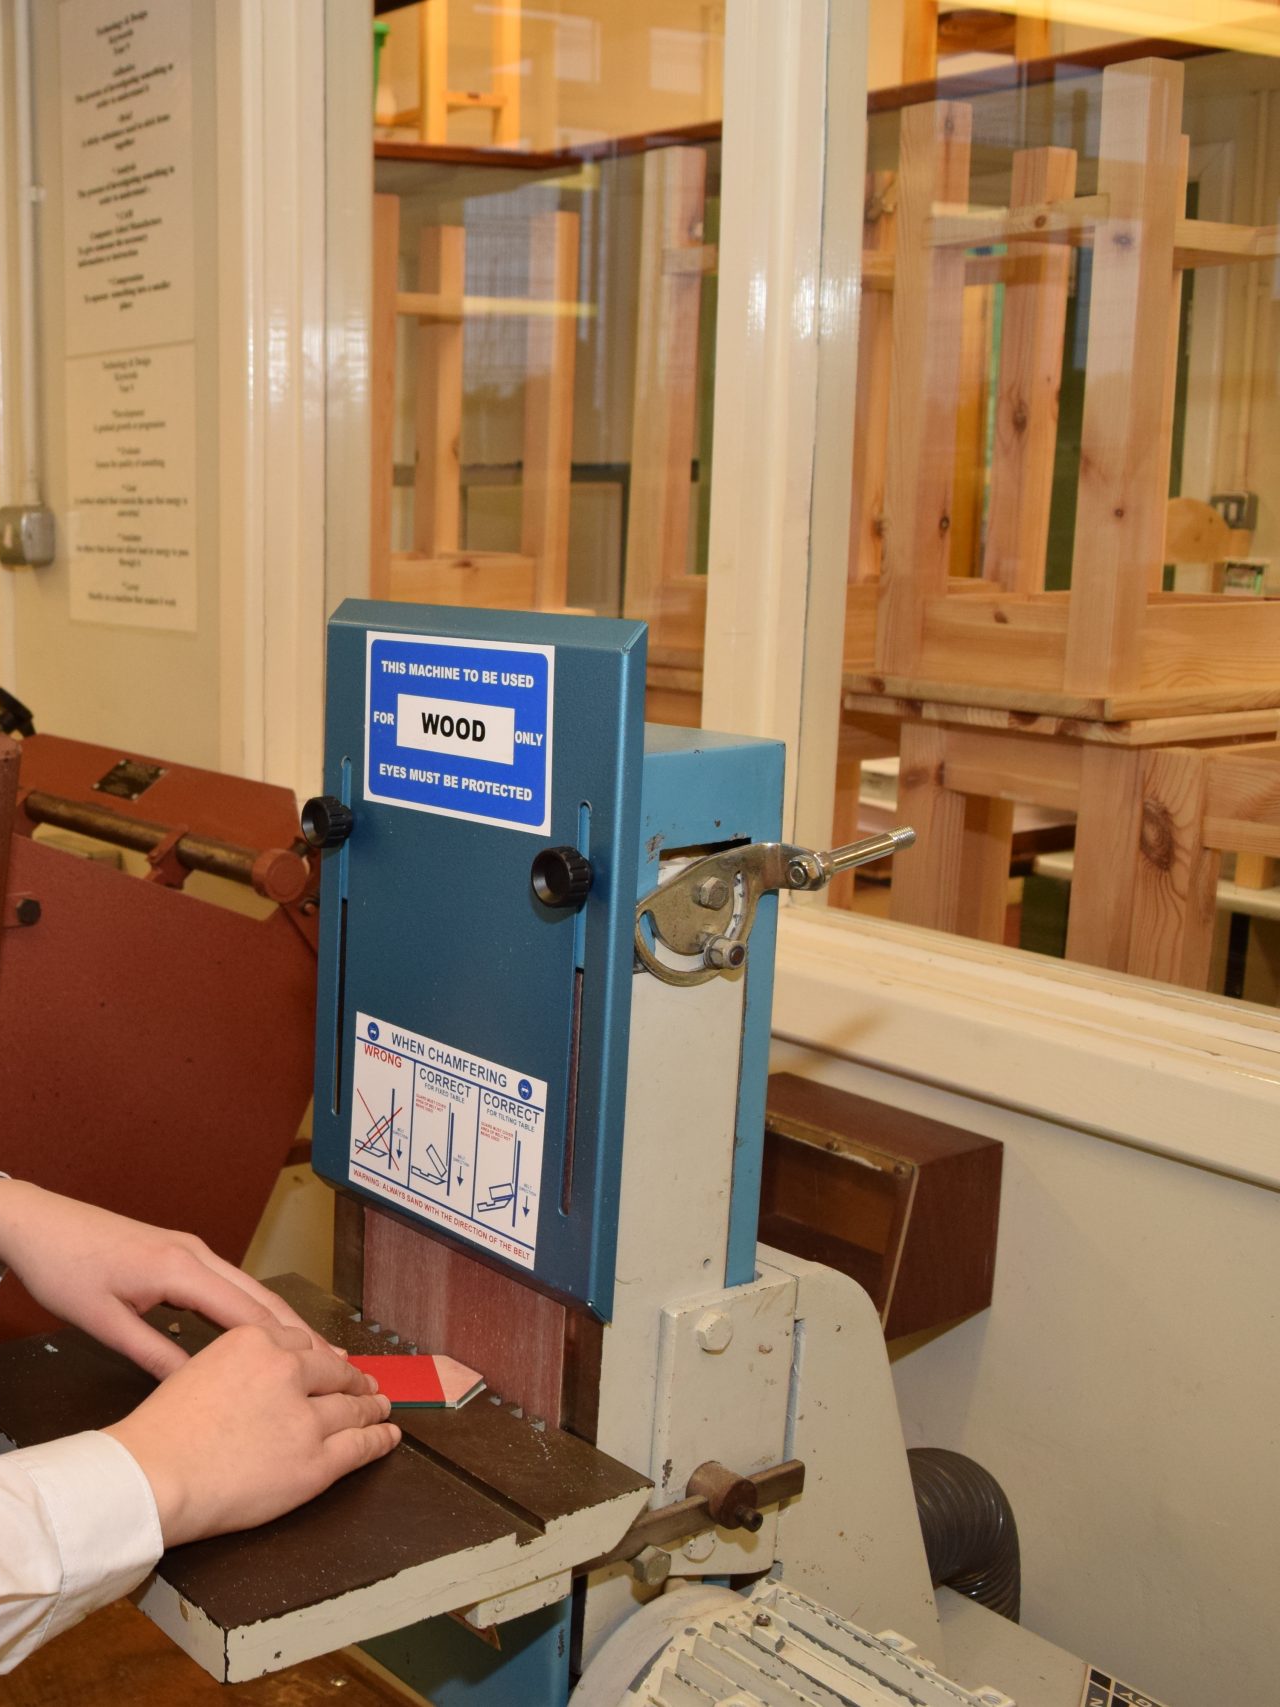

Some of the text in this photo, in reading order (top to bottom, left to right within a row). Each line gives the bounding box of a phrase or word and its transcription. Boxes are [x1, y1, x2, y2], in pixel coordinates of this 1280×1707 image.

[381, 660, 534, 688] THIS MACHINE TO BE USED
[373, 711, 543, 747] FOR WOOD ONLY
[379, 763, 532, 801] EYES MUST BE PROTECTED
[364, 1043, 402, 1068] WRONG
[391, 1032, 507, 1088] WHEN CHAMFERING
[420, 1068, 471, 1098] CORRECT
[424, 1083, 465, 1104] FOR FIXED TABLE
[484, 1093, 540, 1124] CORRECT
[487, 1109, 535, 1133] FOR TILTING TABLE
[353, 1169, 530, 1260] WARNING: ALWAYS SAND WITH THE DIRECTION OF THE BELT
